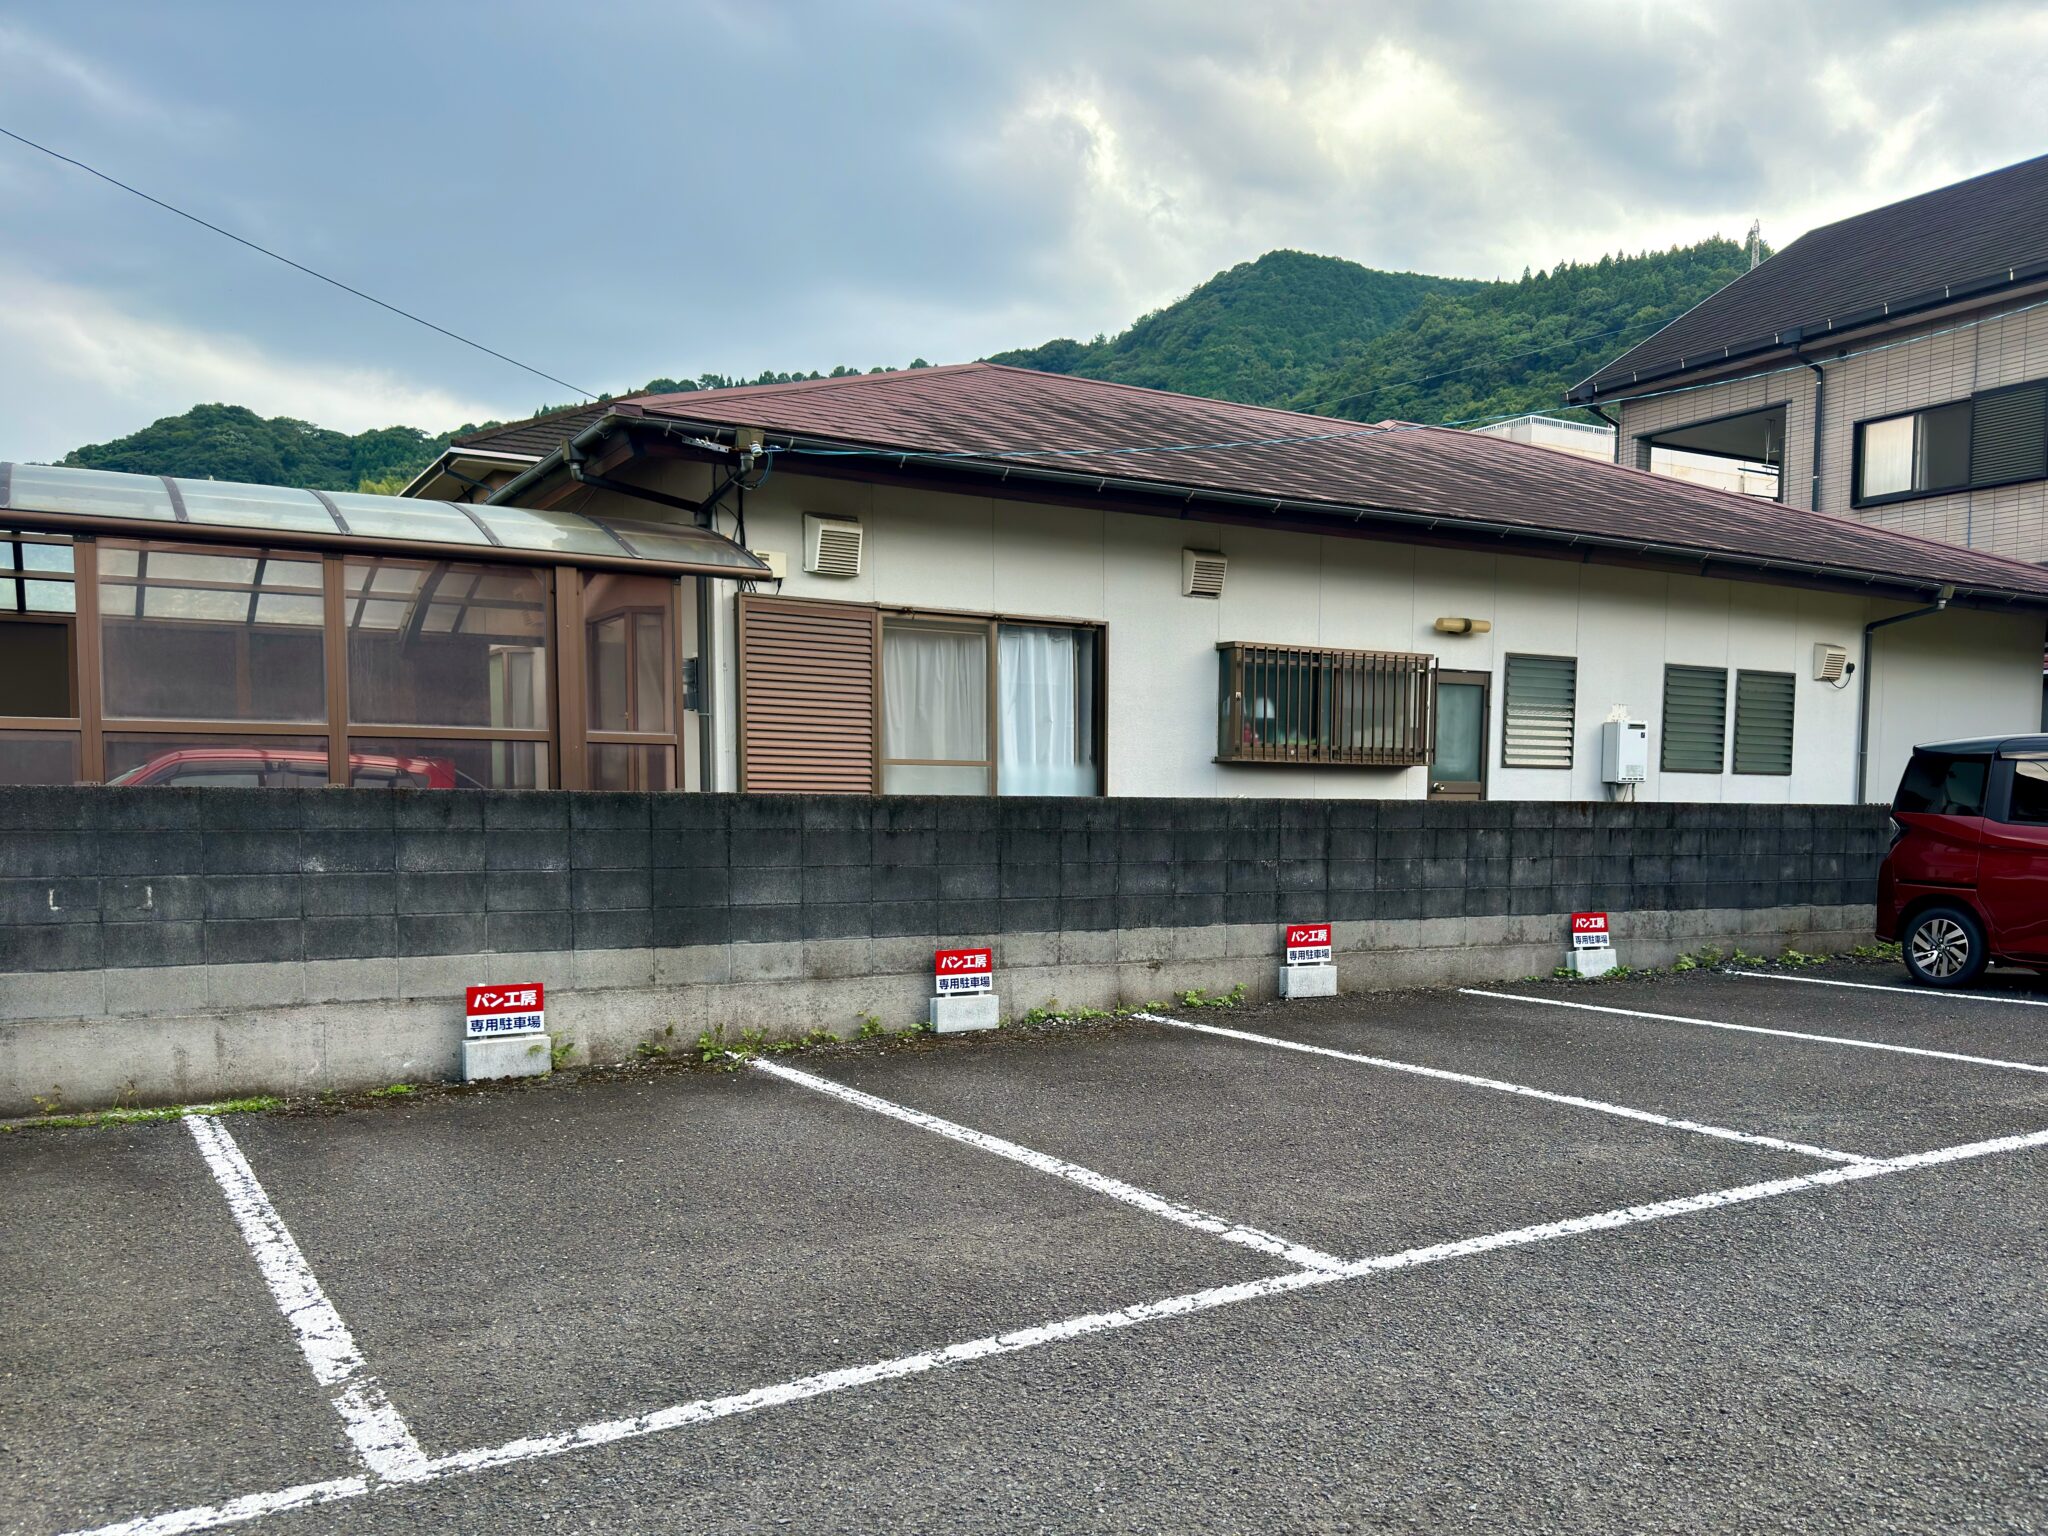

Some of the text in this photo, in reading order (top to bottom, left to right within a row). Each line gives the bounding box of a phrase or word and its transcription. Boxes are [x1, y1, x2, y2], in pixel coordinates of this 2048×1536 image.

[1576, 917, 1604, 928] パン工房
[1291, 929, 1327, 942] パン工房
[1575, 935, 1607, 944] 専用駐車場
[941, 953, 987, 969] パン工房
[1289, 949, 1329, 960] 専用駐車場
[939, 976, 990, 990] 専用駐車場
[473, 990, 537, 1008] パン工房
[470, 1015, 541, 1032] 専用駐車場
